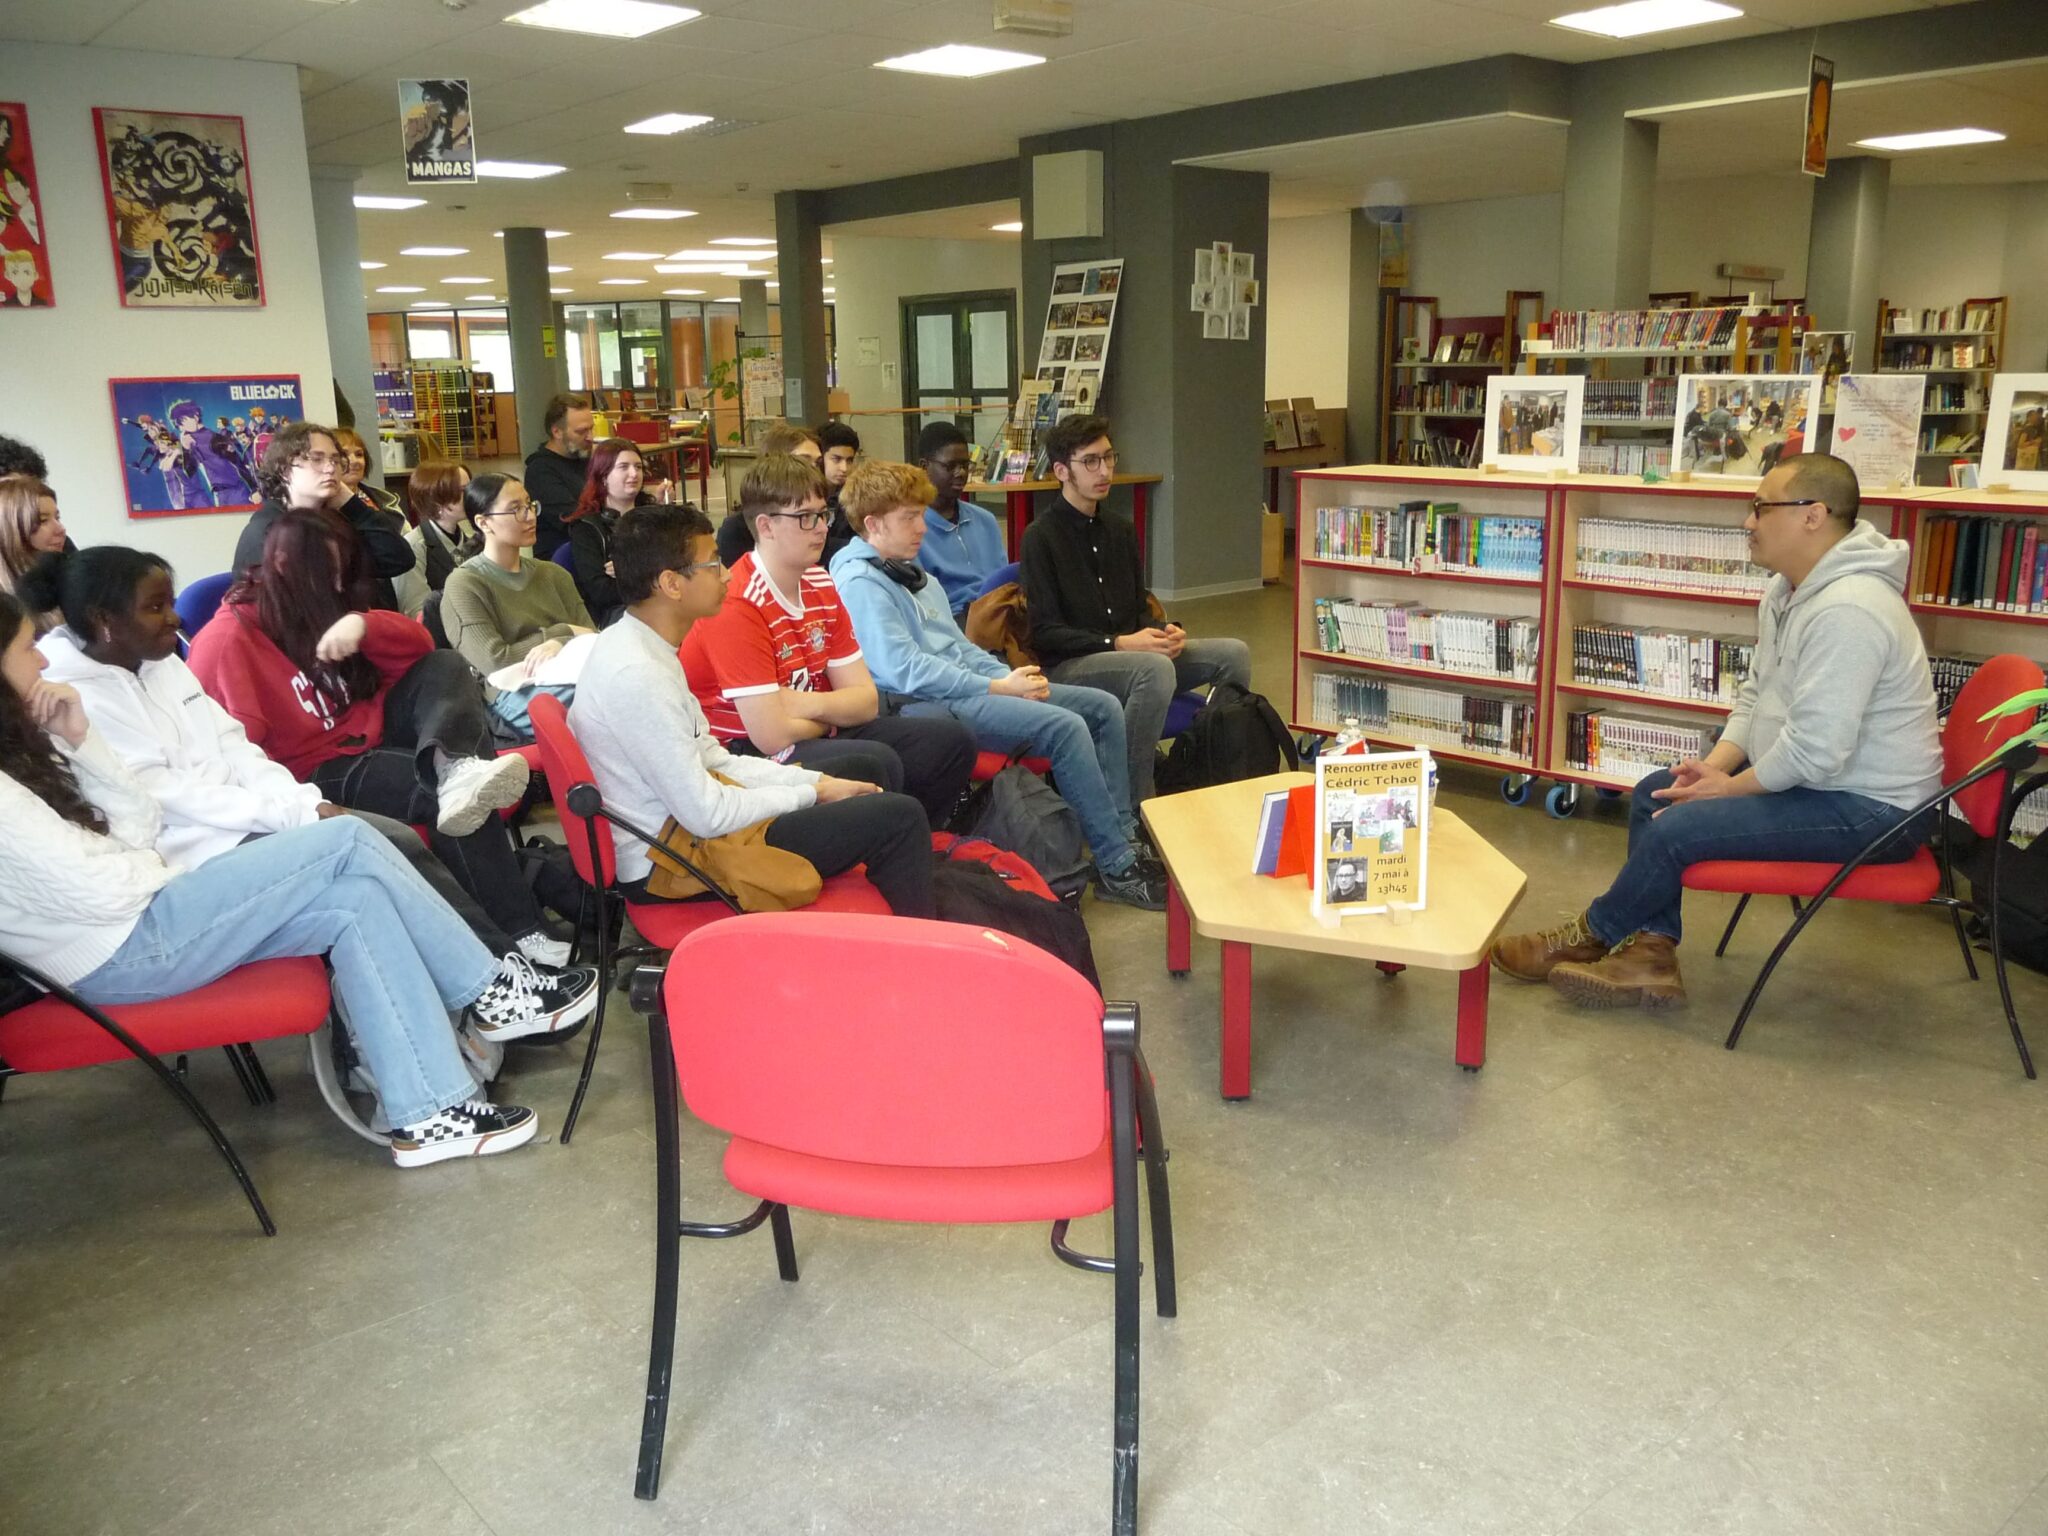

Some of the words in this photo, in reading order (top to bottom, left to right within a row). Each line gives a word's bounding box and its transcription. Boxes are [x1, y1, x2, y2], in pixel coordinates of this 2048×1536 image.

[412, 162, 472, 176] MANGAS
[230, 384, 297, 400] BLUELOCK
[1324, 761, 1388, 774] Rencontre
[1391, 760, 1419, 770] avec
[1326, 775, 1370, 788] Cédric
[1374, 774, 1417, 785] Tchao
[1376, 855, 1407, 866] mardi
[1373, 872, 1380, 881] 7
[1382, 871, 1401, 879] mai
[1403, 869, 1409, 878] à
[1378, 884, 1407, 895] 13h45
